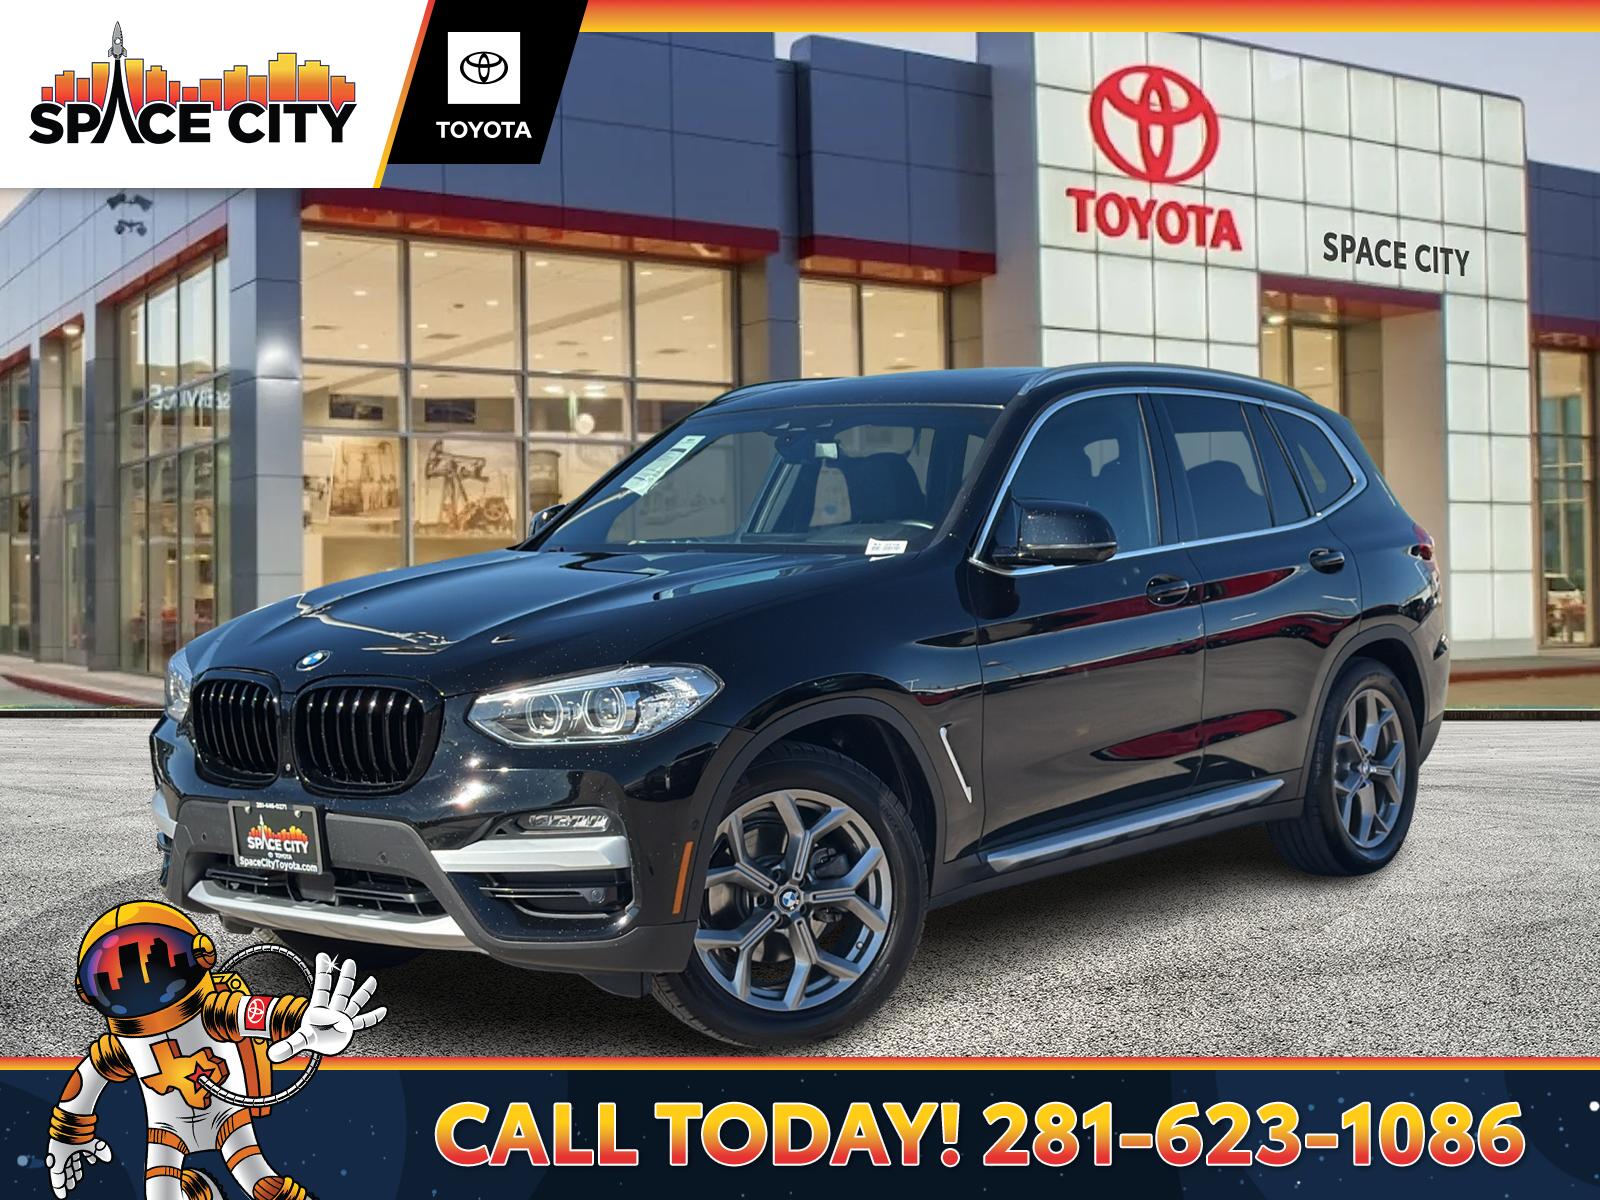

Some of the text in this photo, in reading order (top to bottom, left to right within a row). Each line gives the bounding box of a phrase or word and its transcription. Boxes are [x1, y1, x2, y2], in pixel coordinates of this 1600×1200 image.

[1066, 188, 1242, 251] TOYOTA
[1323, 232, 1470, 277] SPACE CITY
[247, 836, 309, 854] SPACE CITY
[239, 856, 318, 872] SpaceCityToyota.com
